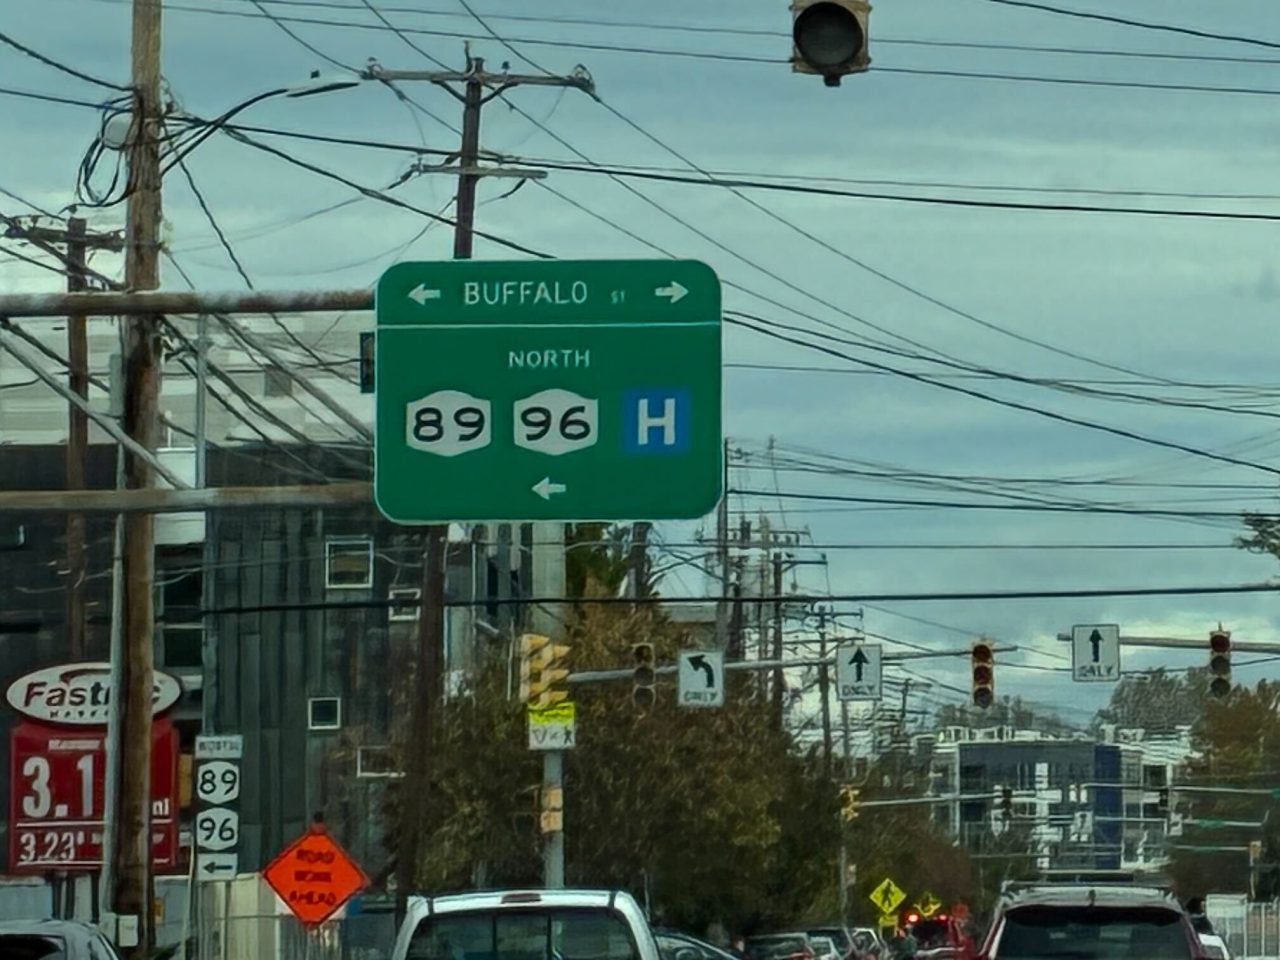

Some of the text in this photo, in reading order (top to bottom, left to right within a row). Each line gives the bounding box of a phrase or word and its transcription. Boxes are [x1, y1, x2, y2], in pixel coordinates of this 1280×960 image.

[464, 281, 588, 305] BUFFALO
[508, 350, 591, 368] NORTH
[413, 398, 676, 445] 89 96 H
[199, 769, 238, 795] 89
[199, 818, 235, 841] 96
